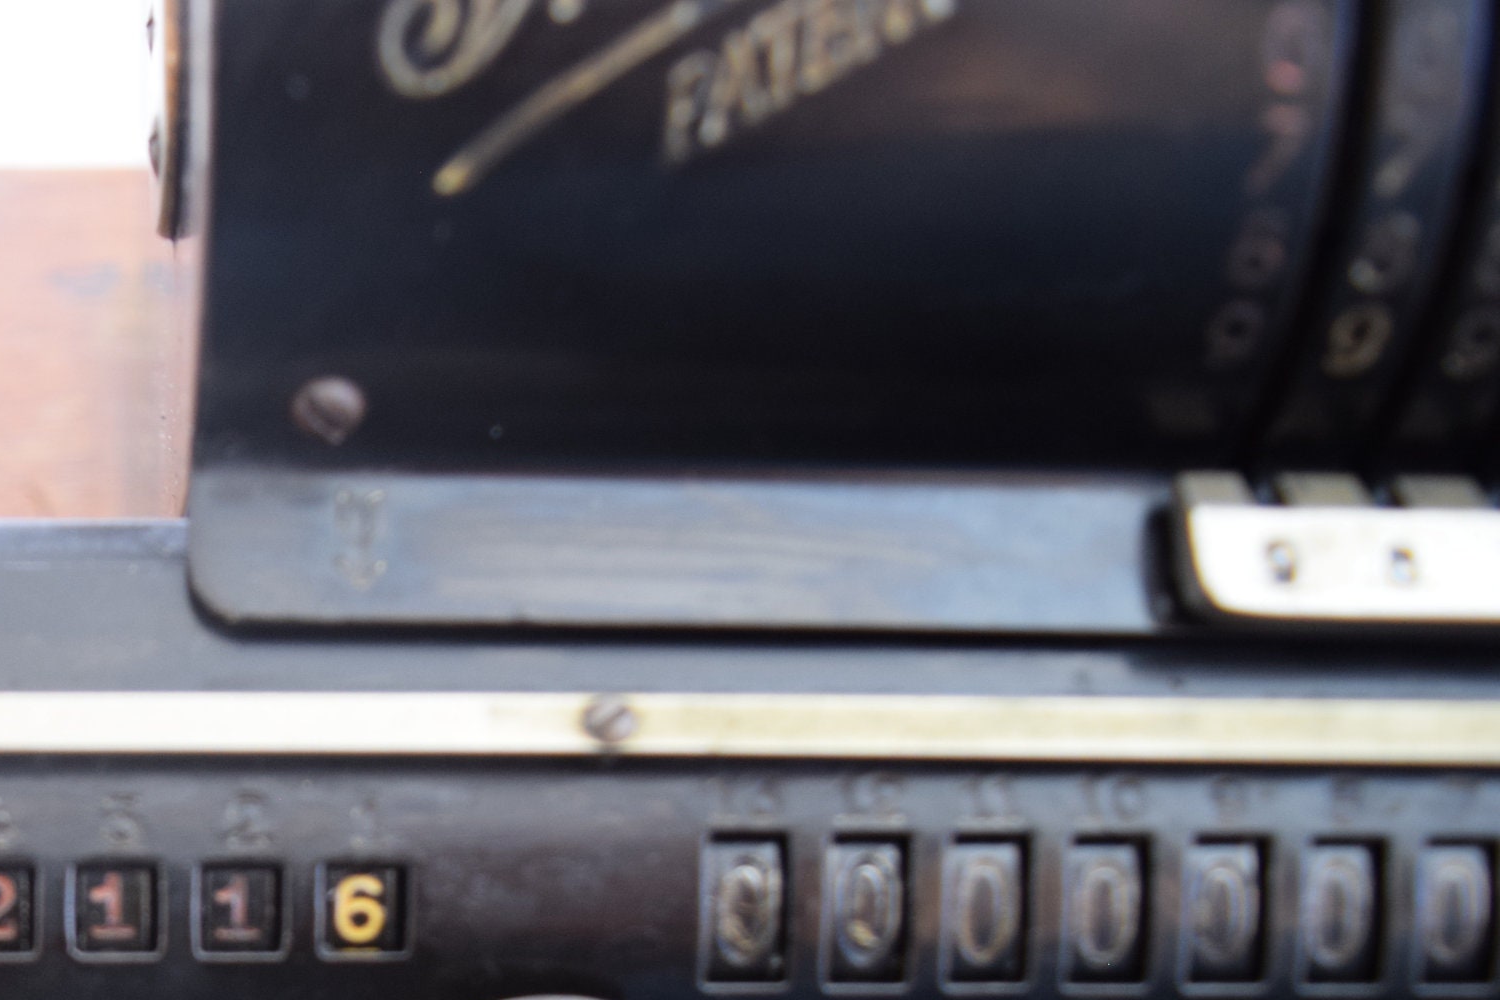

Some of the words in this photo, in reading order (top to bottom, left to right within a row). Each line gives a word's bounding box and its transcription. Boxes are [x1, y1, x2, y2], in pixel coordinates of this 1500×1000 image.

[88, 873, 138, 941] 1
[213, 873, 264, 942] 1
[333, 873, 387, 943] 6
[957, 864, 1016, 966] 0
[1076, 865, 1134, 968] 0
[1306, 865, 1364, 968] 0
